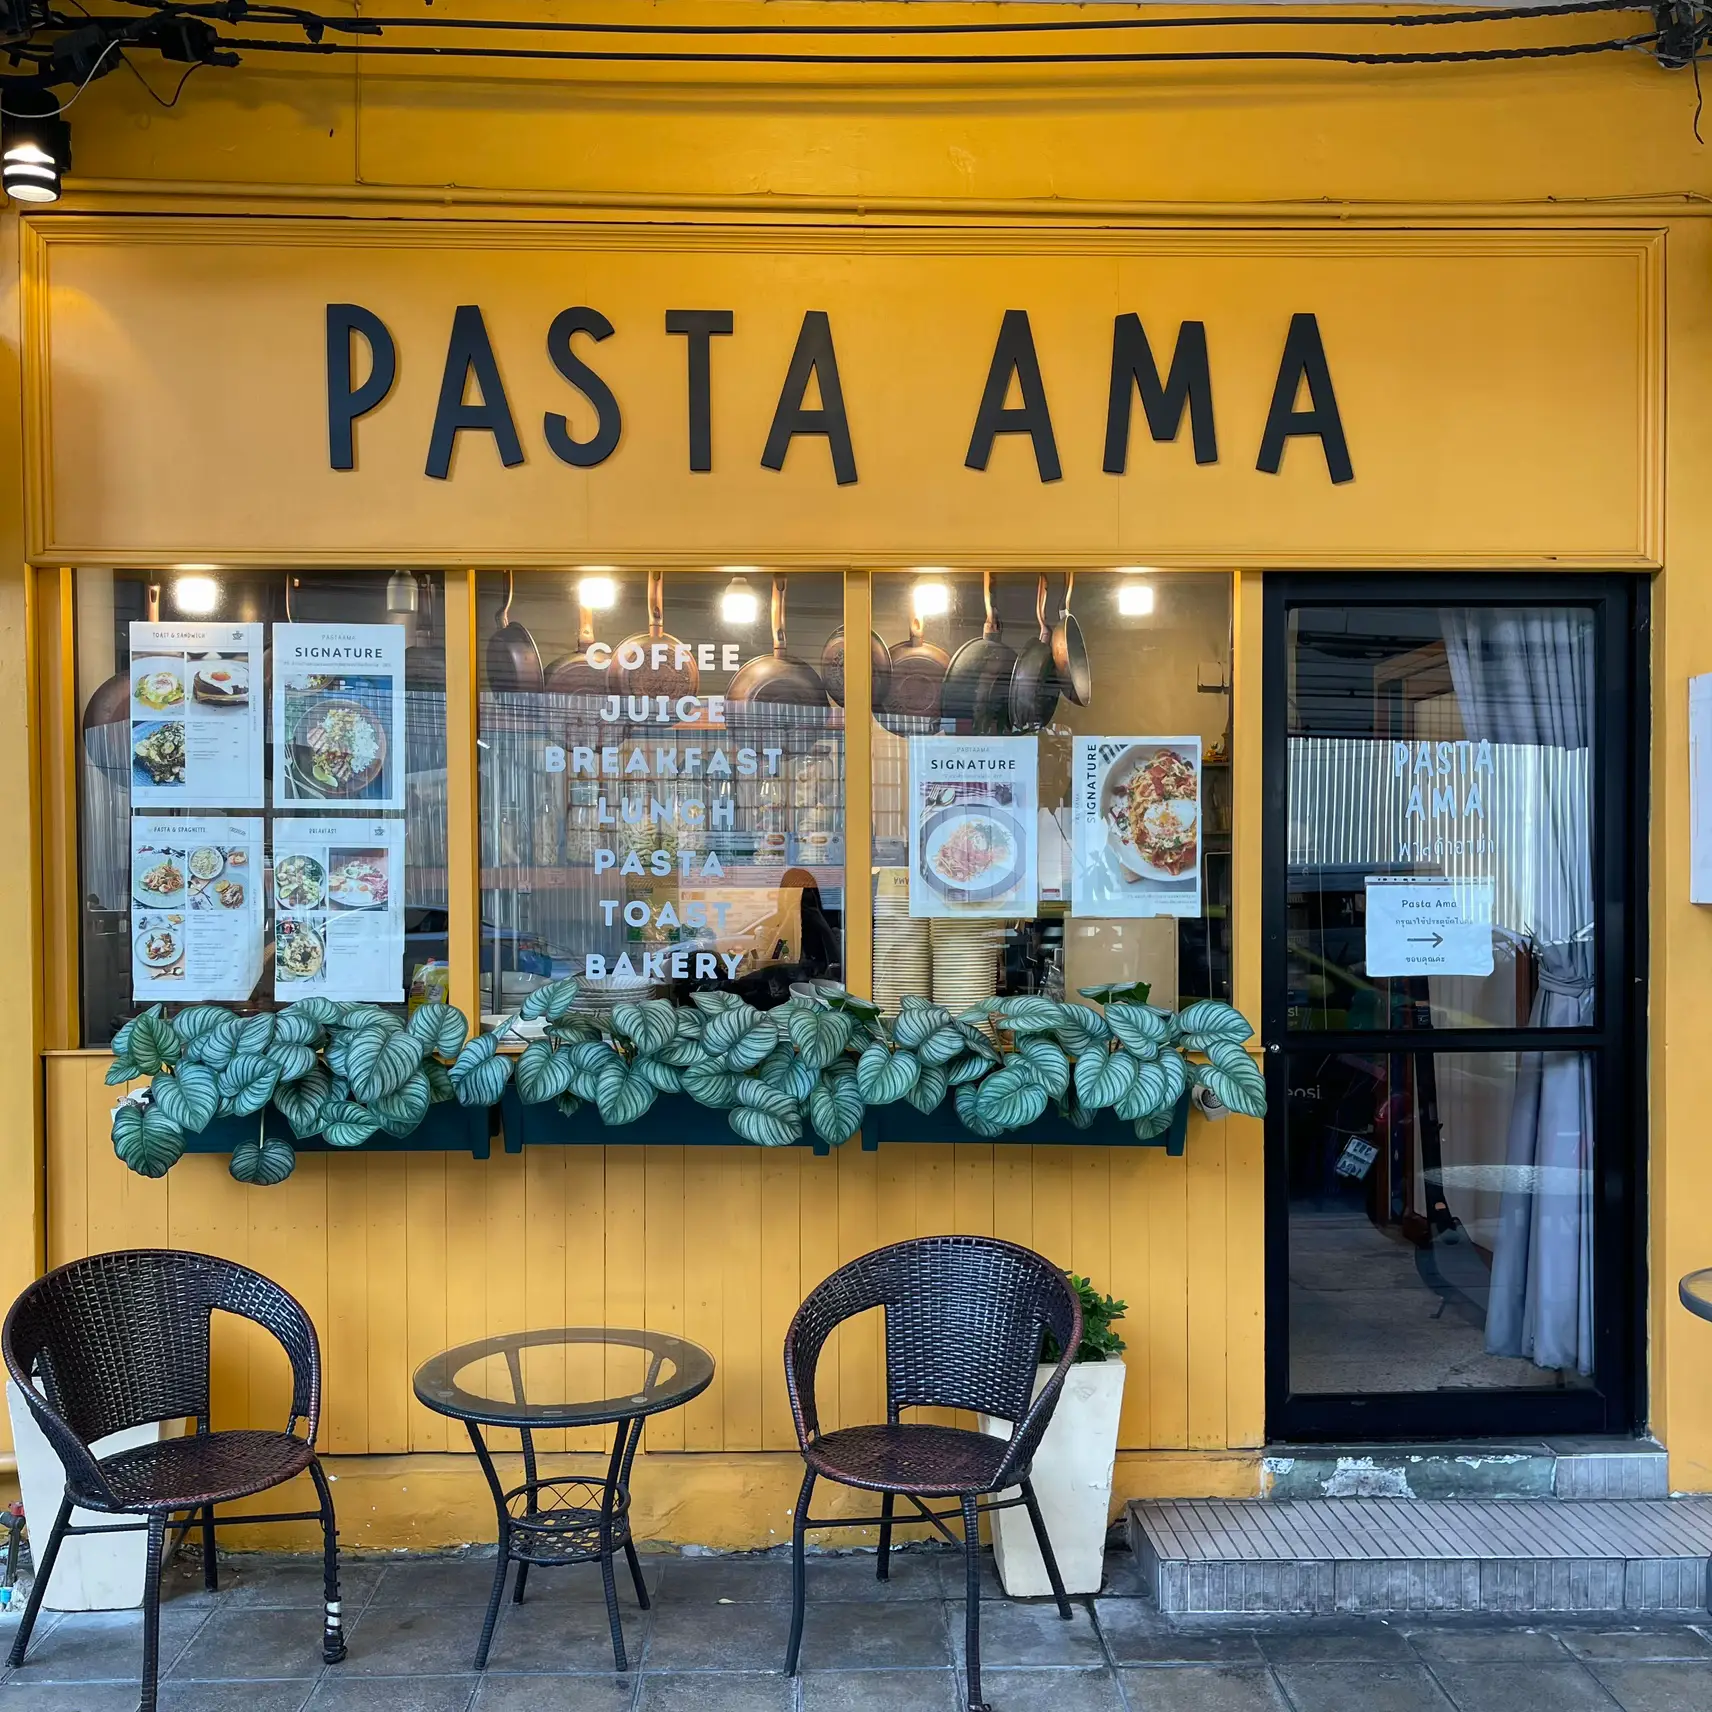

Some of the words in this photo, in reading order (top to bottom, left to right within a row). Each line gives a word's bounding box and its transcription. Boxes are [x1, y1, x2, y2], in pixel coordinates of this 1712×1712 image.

[326, 303, 858, 486] PASTA
[964, 309, 1355, 485] AMA
[295, 647, 383, 658] SIGNATURE
[585, 642, 740, 671] COFFEE
[600, 695, 725, 723] JUICE
[545, 746, 782, 776] BREAKFAST
[931, 759, 1016, 770] SIGNATURE
[1392, 739, 1495, 777] PASTA
[1087, 744, 1097, 824] SIGNATURE
[598, 797, 735, 826] LUNCH
[1404, 782, 1485, 821] AMA
[594, 849, 725, 877] PASTA
[599, 900, 733, 929] TOAST
[1401, 899, 1431, 908] Pasta
[1435, 899, 1457, 908] Ama
[585, 951, 744, 980] BAKERY
